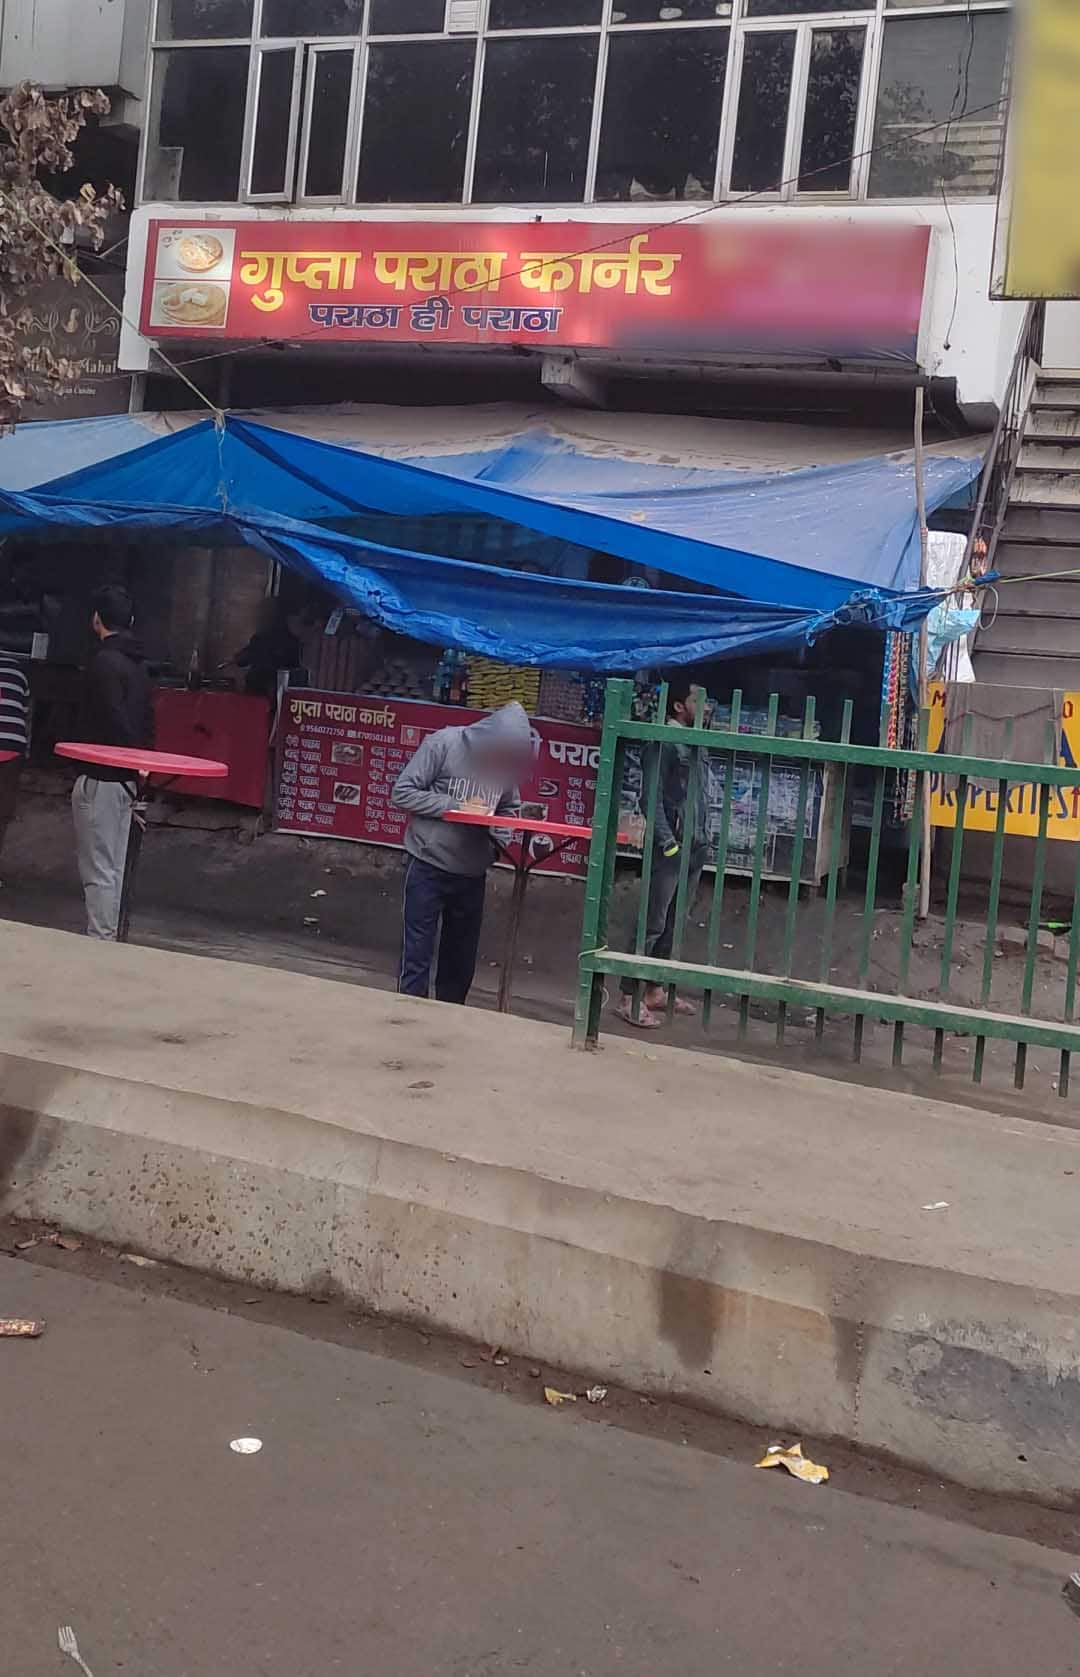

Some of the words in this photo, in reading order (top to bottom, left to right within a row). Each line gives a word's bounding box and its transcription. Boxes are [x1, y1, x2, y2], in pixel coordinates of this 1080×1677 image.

[240, 251, 361, 310] गुप्ता
[373, 251, 507, 292] पराठा
[519, 235, 682, 296] कार्नर
[308, 304, 403, 330] पराठा
[409, 297, 453, 332] ही
[461, 306, 564, 332] पराठा
[290, 699, 322, 724] गुप्ता
[325, 703, 357, 723] पराठा
[359, 705, 396, 728] कार्नर
